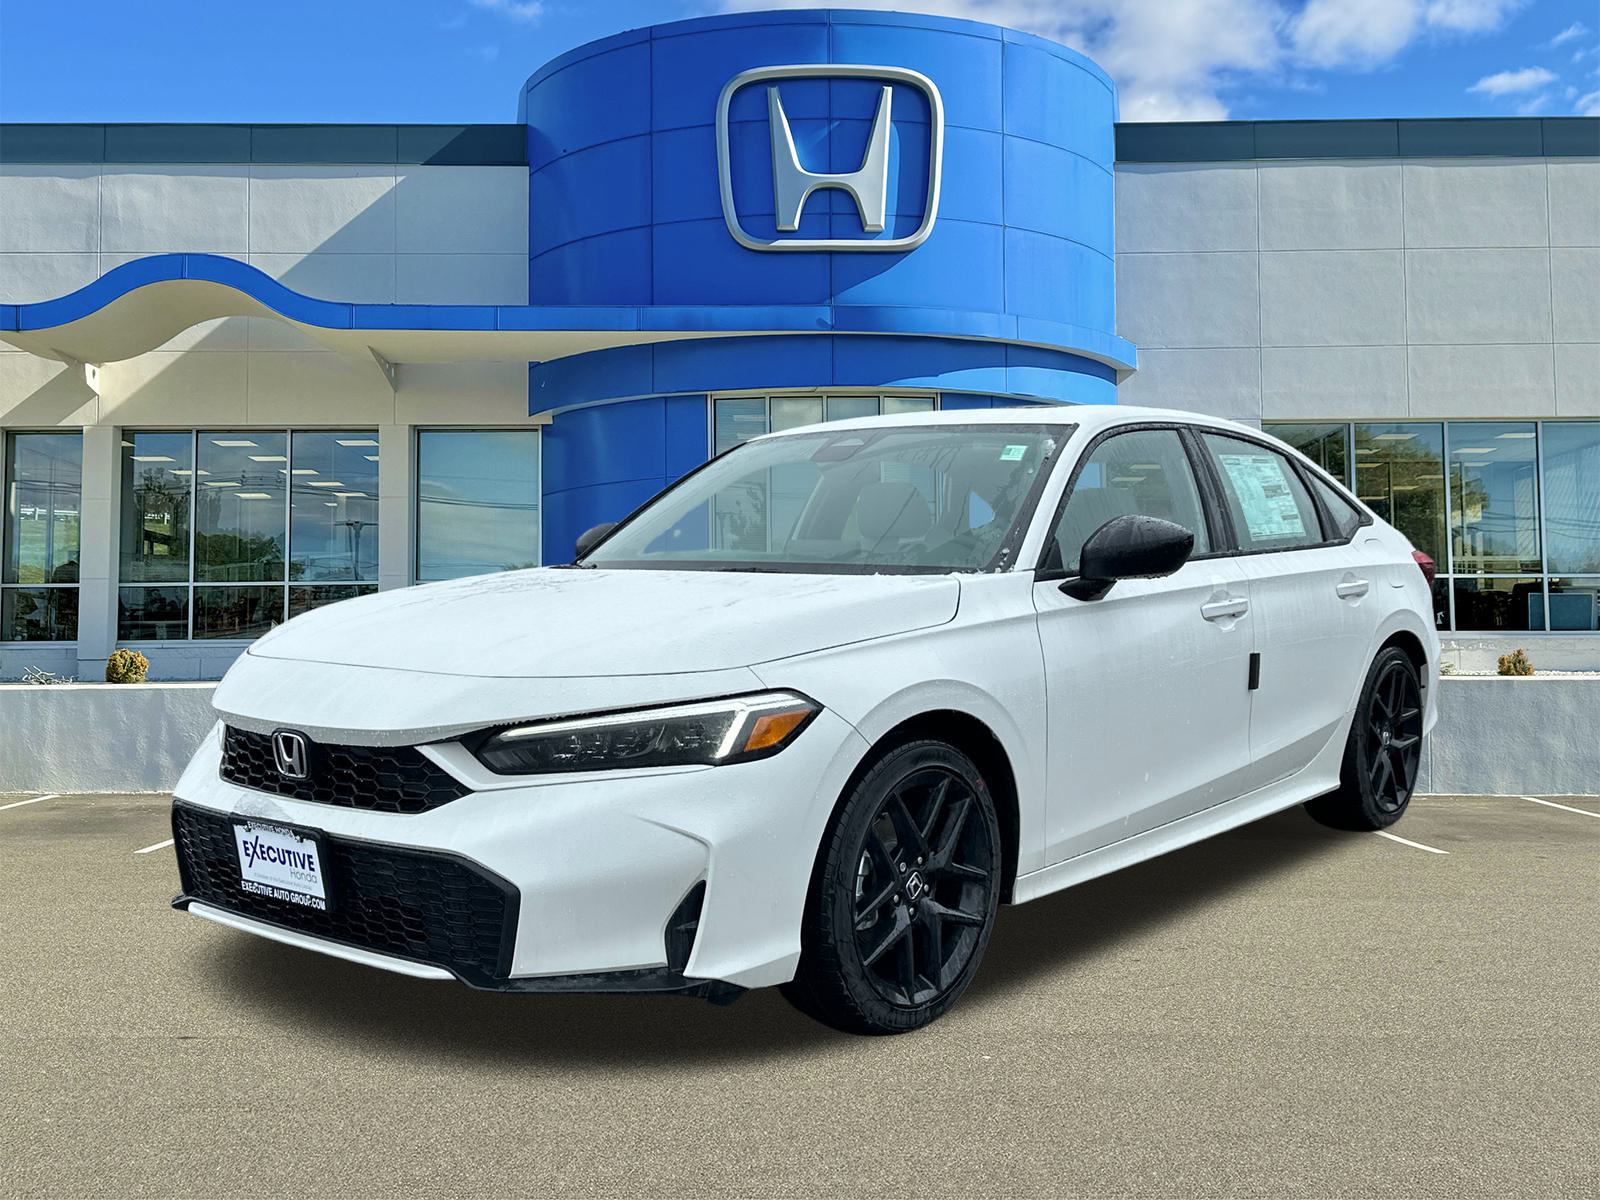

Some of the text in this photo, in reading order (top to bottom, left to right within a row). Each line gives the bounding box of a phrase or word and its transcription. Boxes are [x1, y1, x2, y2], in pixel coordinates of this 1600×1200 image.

[242, 835, 316, 872] EXECUTIVE
[241, 881, 273, 897] EXECUTIVE
[274, 889, 290, 902] AUTO
[290, 892, 326, 911] GROUP.COM
